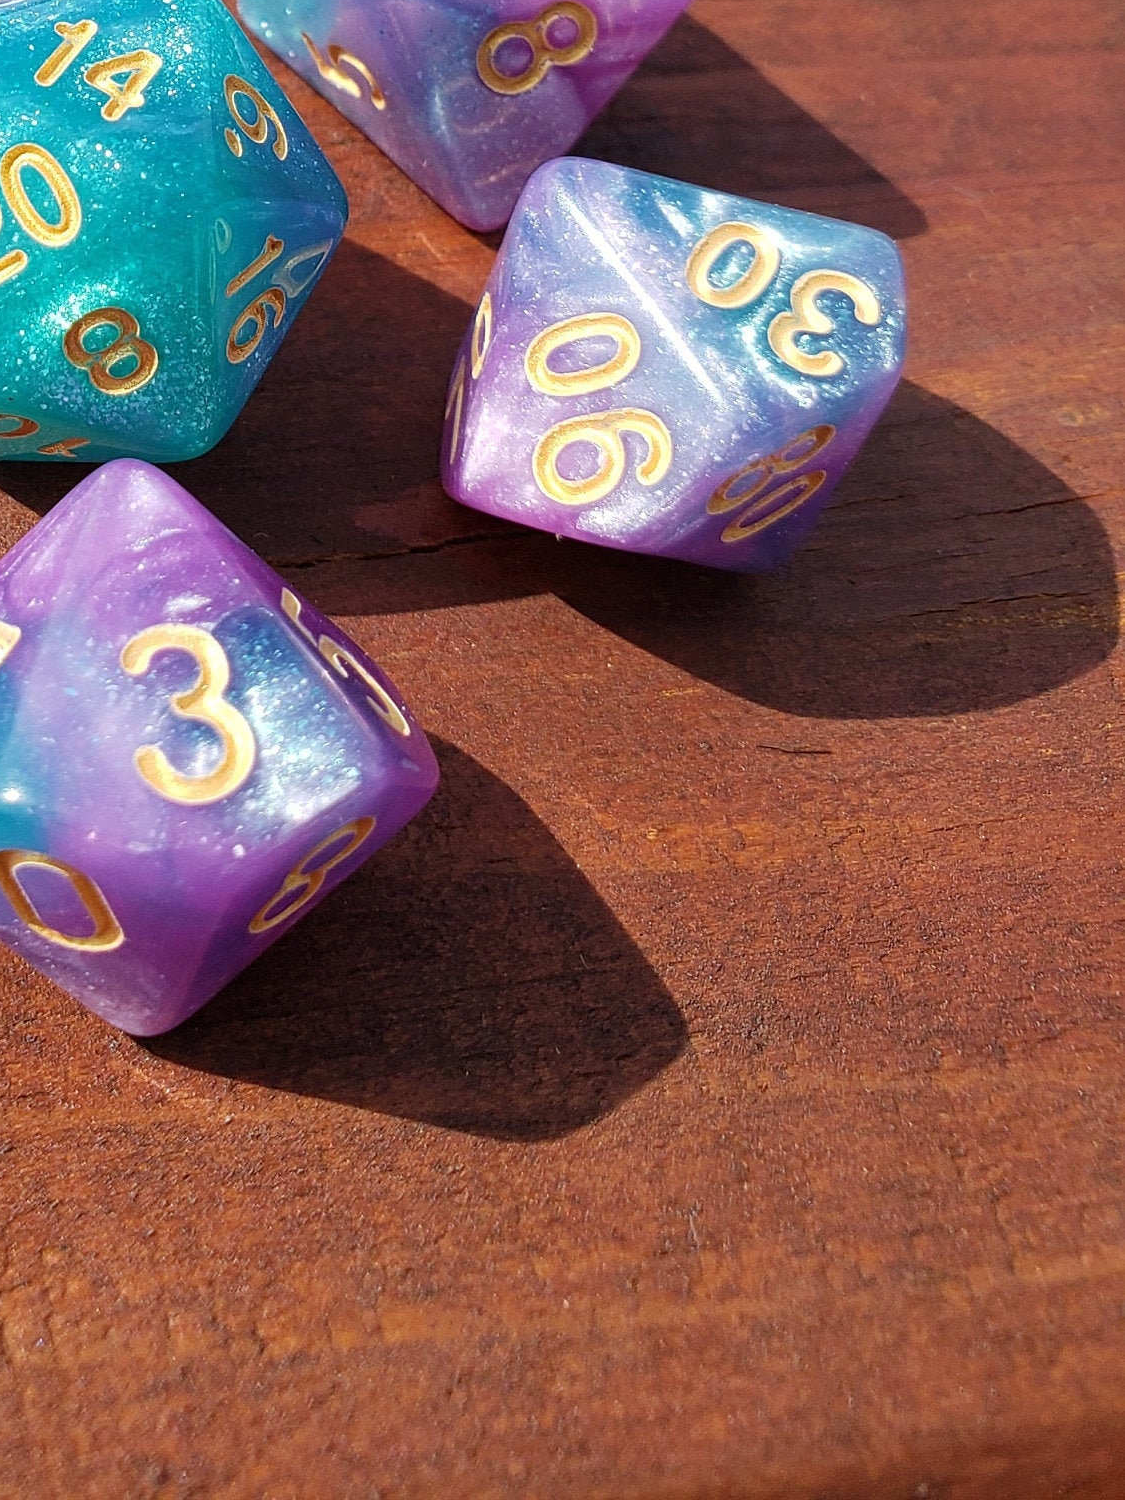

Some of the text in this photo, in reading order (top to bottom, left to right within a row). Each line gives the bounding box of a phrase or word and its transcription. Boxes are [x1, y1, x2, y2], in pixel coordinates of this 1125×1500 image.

[34, 19, 163, 121] 14
[477, 1, 597, 95] 8
[62, 307, 159, 395] 8
[226, 234, 286, 364] 16
[685, 221, 881, 377] 30
[706, 424, 836, 542] 80
[120, 622, 256, 806] 3
[249, 816, 375, 933] 8
